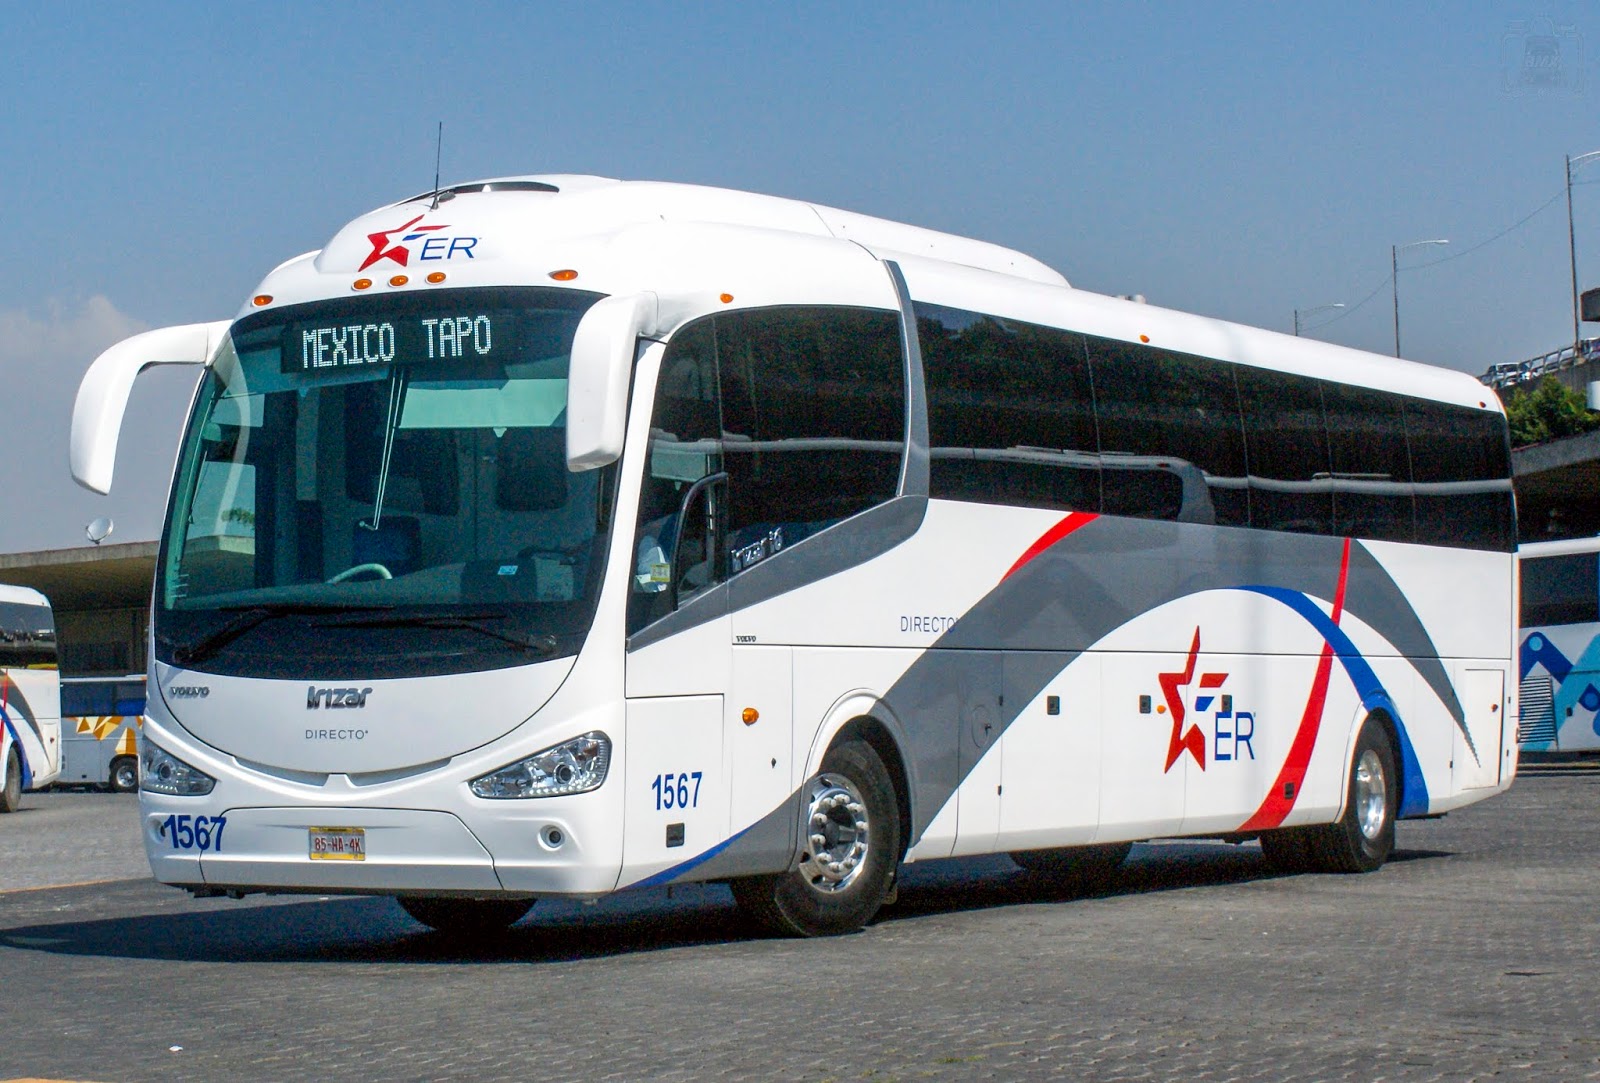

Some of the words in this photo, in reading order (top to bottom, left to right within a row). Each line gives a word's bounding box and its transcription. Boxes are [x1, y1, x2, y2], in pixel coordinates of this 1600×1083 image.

[420, 236, 480, 261] ER
[302, 322, 395, 369] MEXICO
[421, 315, 492, 359] TAPO
[169, 686, 211, 699] VOLVO
[1214, 711, 1256, 761] ER
[651, 771, 703, 811] 1567
[163, 814, 227, 852] 1567
